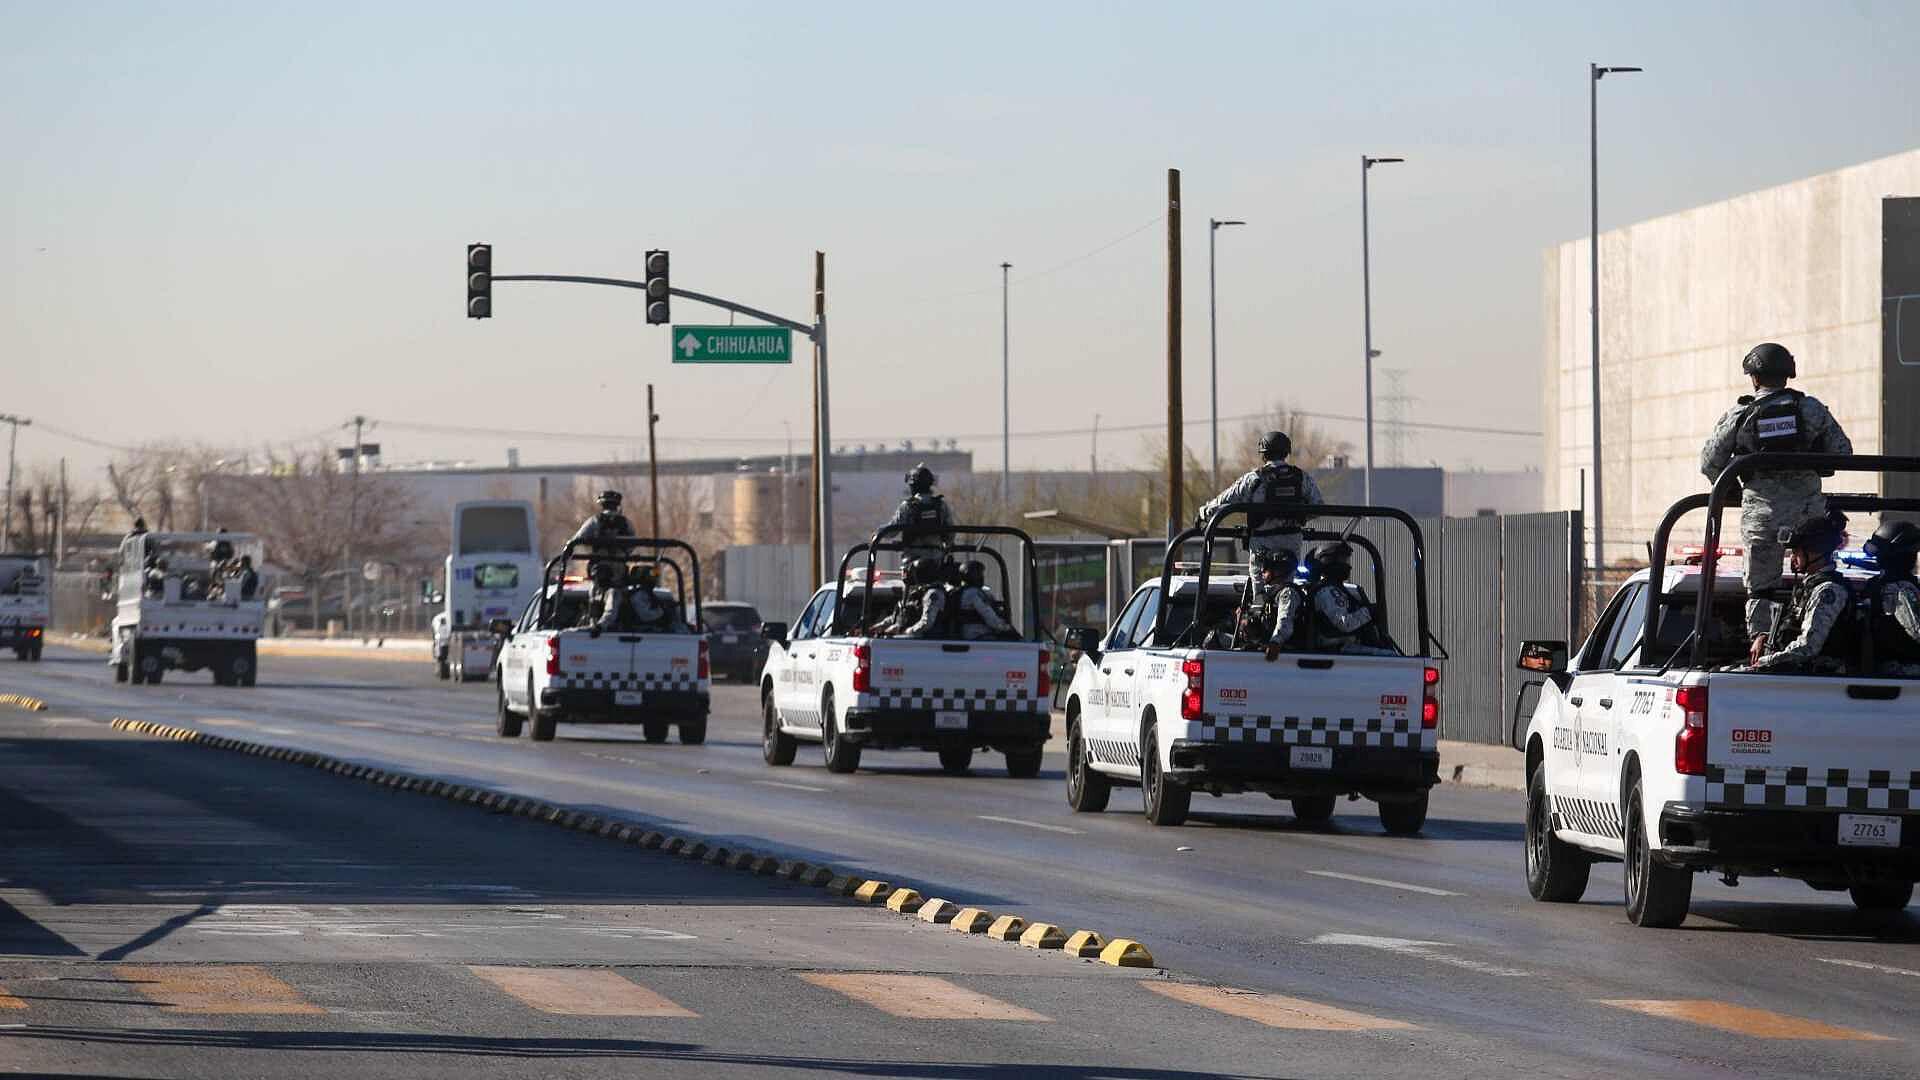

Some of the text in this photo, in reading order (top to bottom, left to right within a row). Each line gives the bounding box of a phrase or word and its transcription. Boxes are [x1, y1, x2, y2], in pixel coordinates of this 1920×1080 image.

[707, 336, 784, 353] CHIHUAHUA
[1111, 689, 1131, 708] NACIONAL
[1630, 690, 1656, 715] 27763
[1553, 726, 1608, 756] GUARDIA NACIONAL
[1732, 729, 1771, 742] 088
[1853, 823, 1886, 837] 27763
